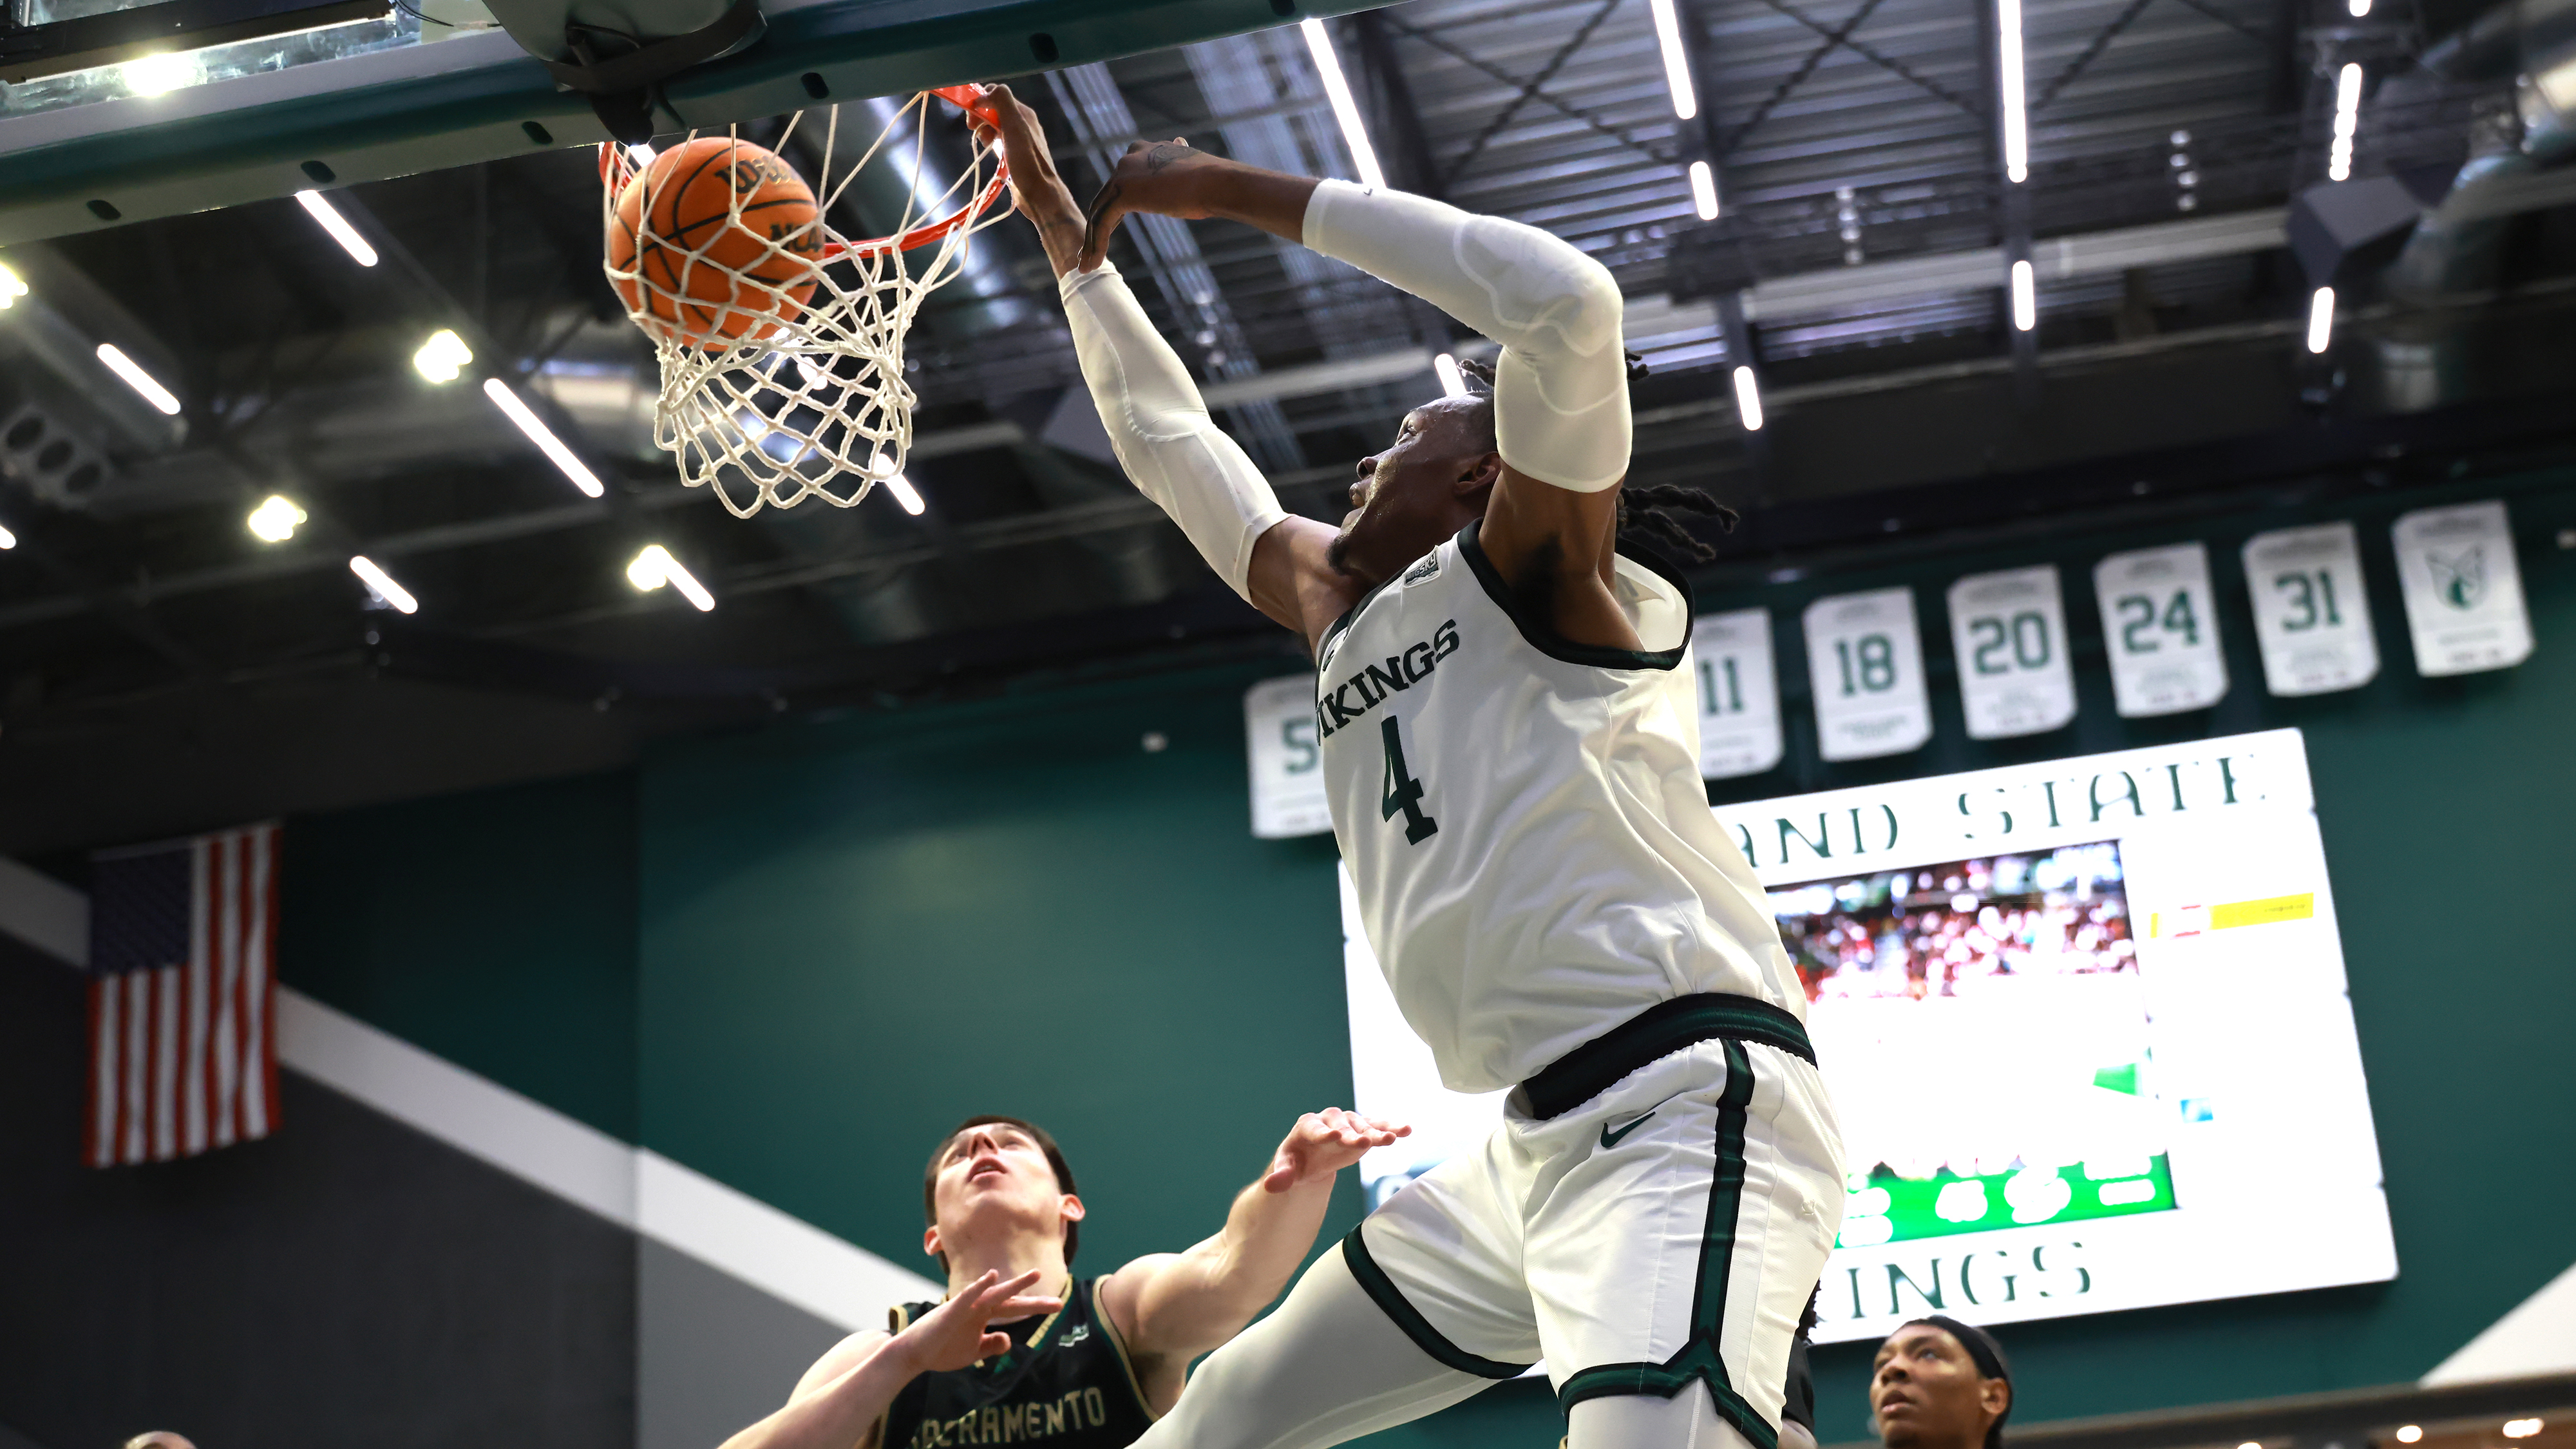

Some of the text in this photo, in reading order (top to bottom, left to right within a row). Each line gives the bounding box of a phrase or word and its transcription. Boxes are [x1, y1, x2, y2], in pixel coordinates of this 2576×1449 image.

[2116, 589, 2200, 653] 24
[2274, 570, 2342, 632] 31
[1835, 632, 1897, 696] 18
[1968, 611, 2050, 675] 20
[1316, 619, 1459, 746] IKINGS
[1700, 656, 1745, 715] 11
[1282, 716, 1318, 775] 5
[1381, 715, 1438, 846] 4
[1958, 753, 2266, 838] STATE
[1816, 1242, 2091, 1322] INGS
